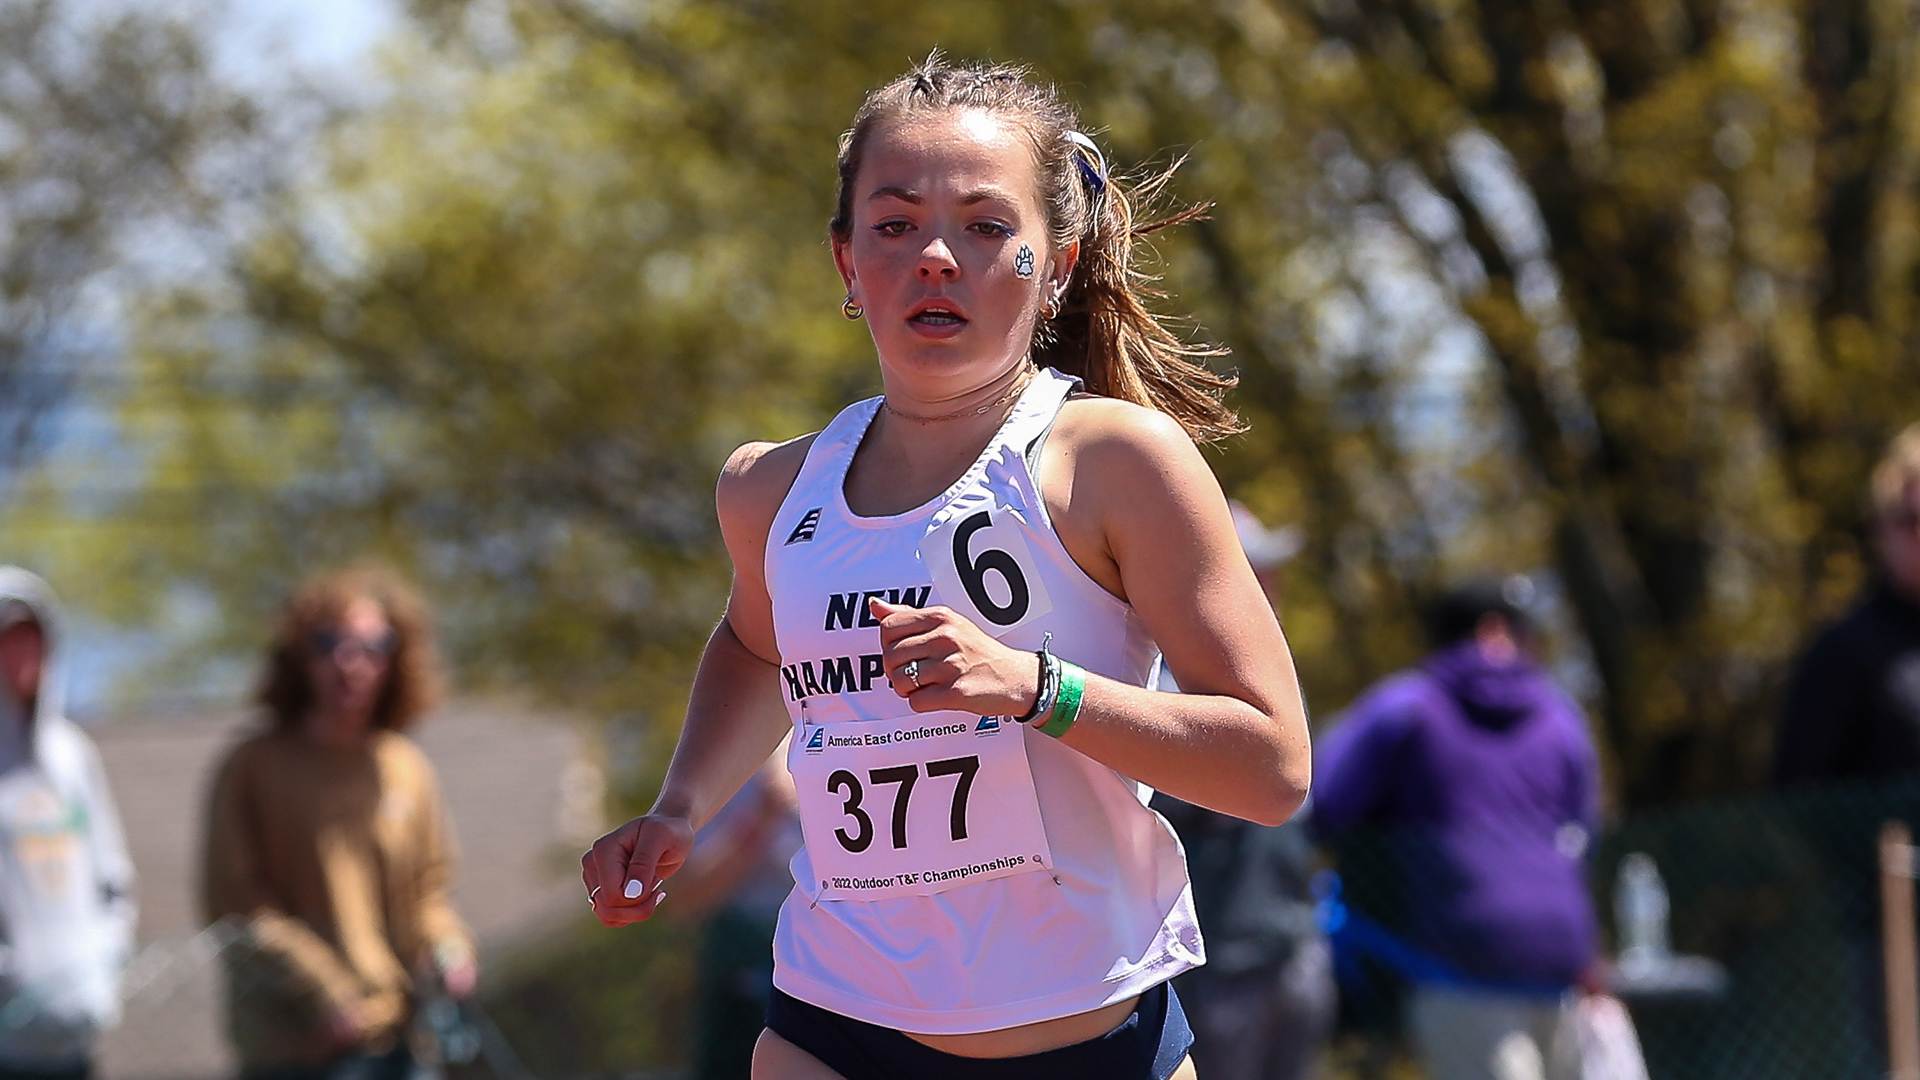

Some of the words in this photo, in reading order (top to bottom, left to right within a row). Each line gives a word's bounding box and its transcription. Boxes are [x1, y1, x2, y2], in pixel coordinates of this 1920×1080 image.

[952, 510, 1030, 626] 6
[824, 585, 933, 631] NEW
[781, 653, 894, 702] HAMP
[827, 734, 863, 747] America
[864, 732, 891, 746] East
[893, 723, 967, 742] Conference
[827, 754, 980, 854] 377
[832, 877, 852, 889] 2022
[852, 876, 895, 890] Outdoor
[896, 872, 919, 886] T&F
[923, 855, 1025, 884] Championships
